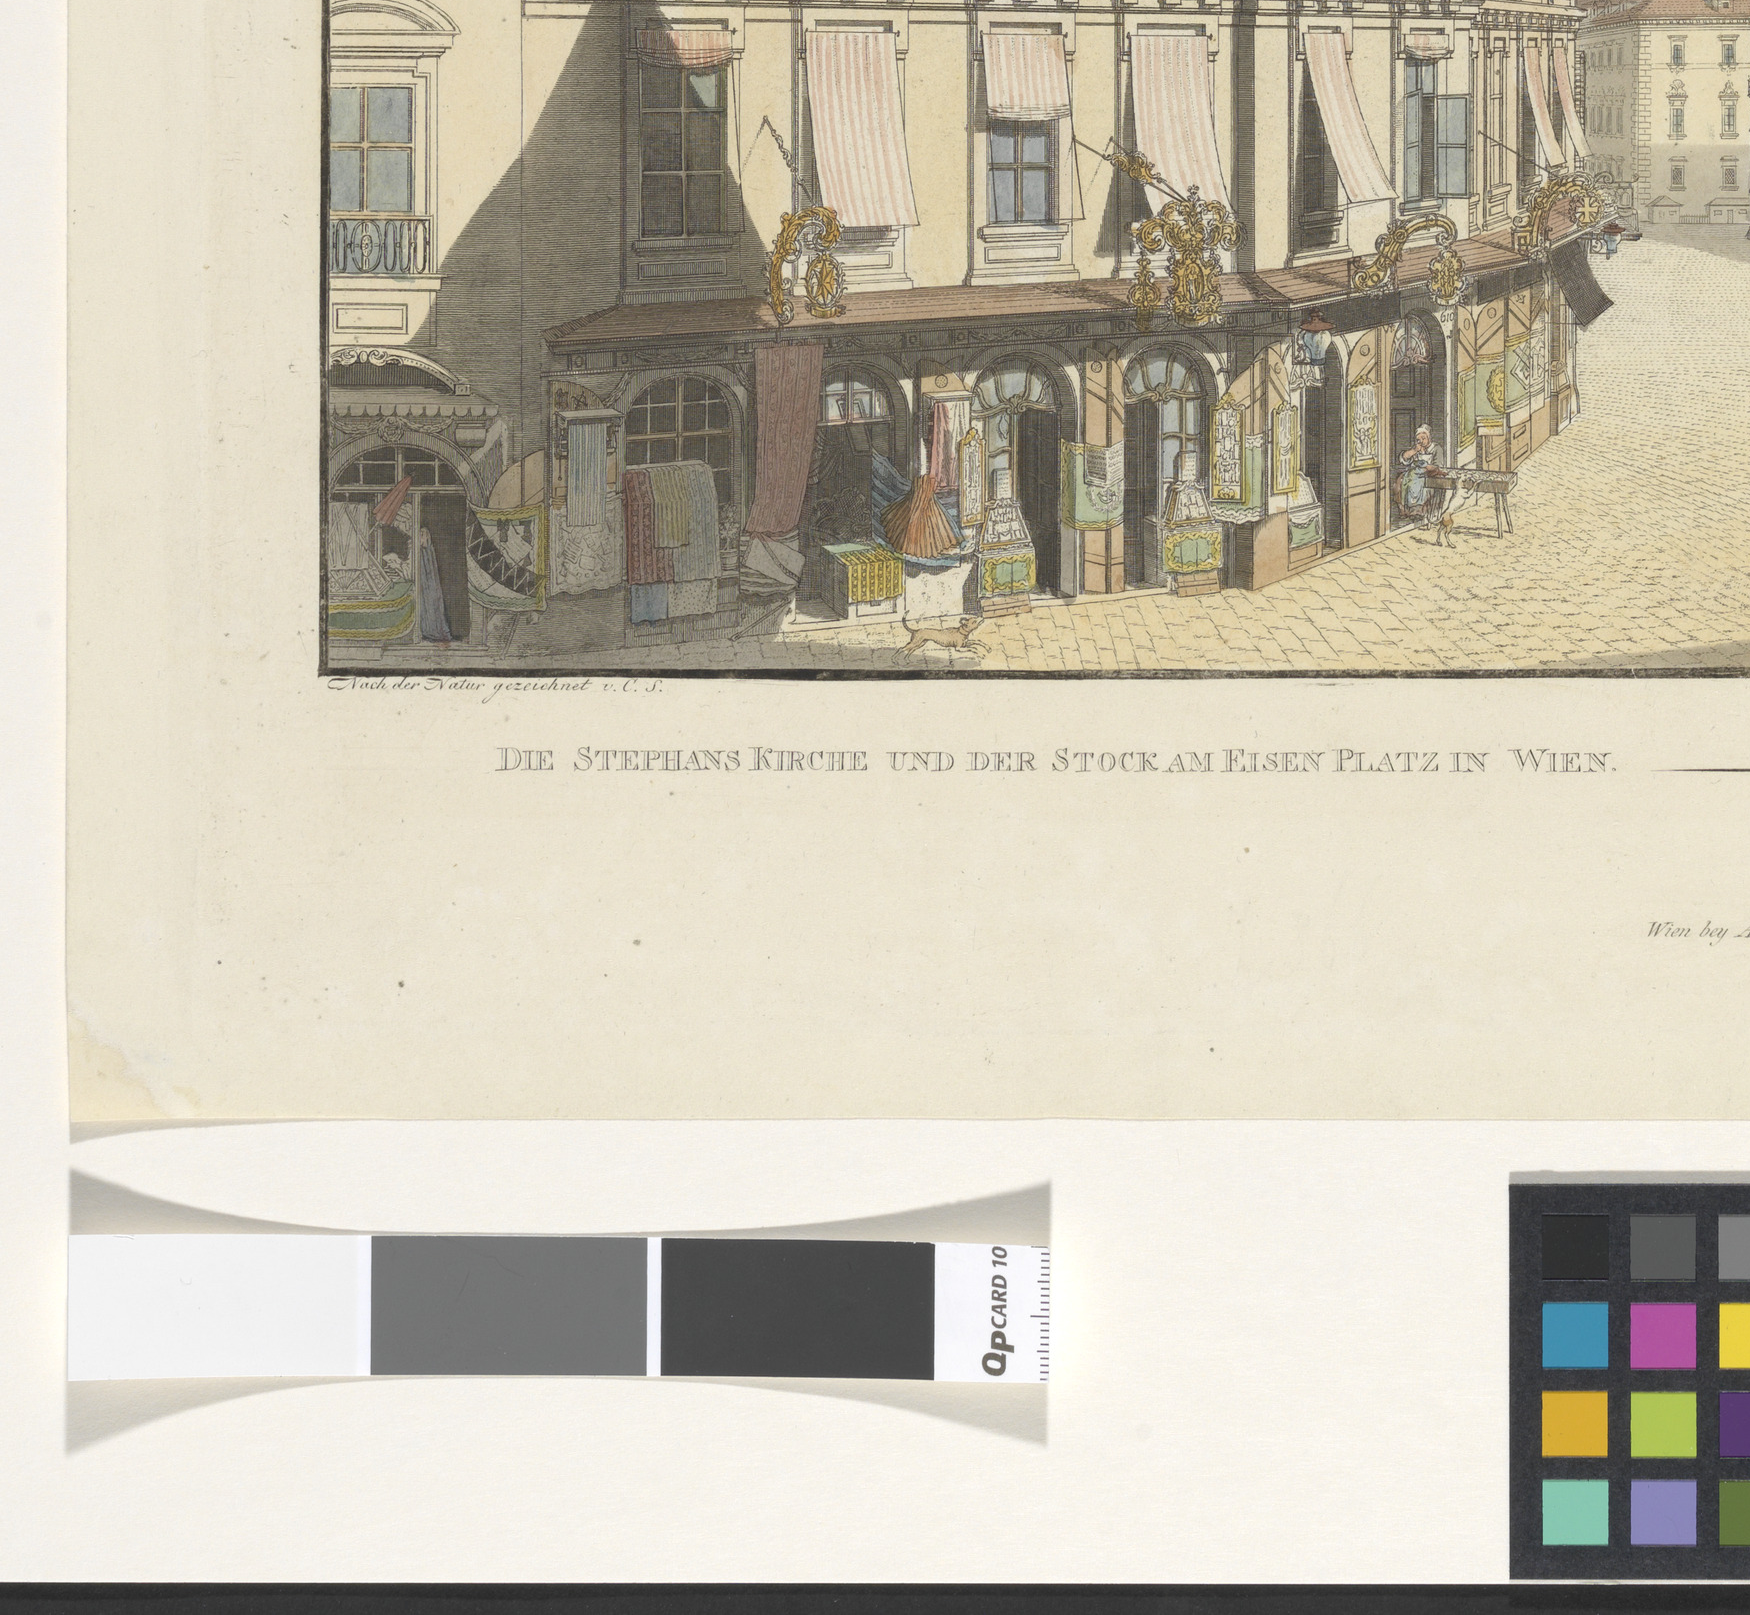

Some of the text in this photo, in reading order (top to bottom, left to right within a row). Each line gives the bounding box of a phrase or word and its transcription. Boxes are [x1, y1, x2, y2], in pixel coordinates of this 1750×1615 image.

[327, 676, 388, 691] Nach
[391, 677, 421, 691] der
[423, 676, 486, 691] Natur
[481, 678, 593, 705] gezeichnet
[495, 745, 1618, 774] DIE STEPHANS KIRCHE UND DER STOCK AM EISEN PLATZ IN WIEN.
[1647, 921, 1692, 938] Wien
[1698, 919, 1729, 947] bey
